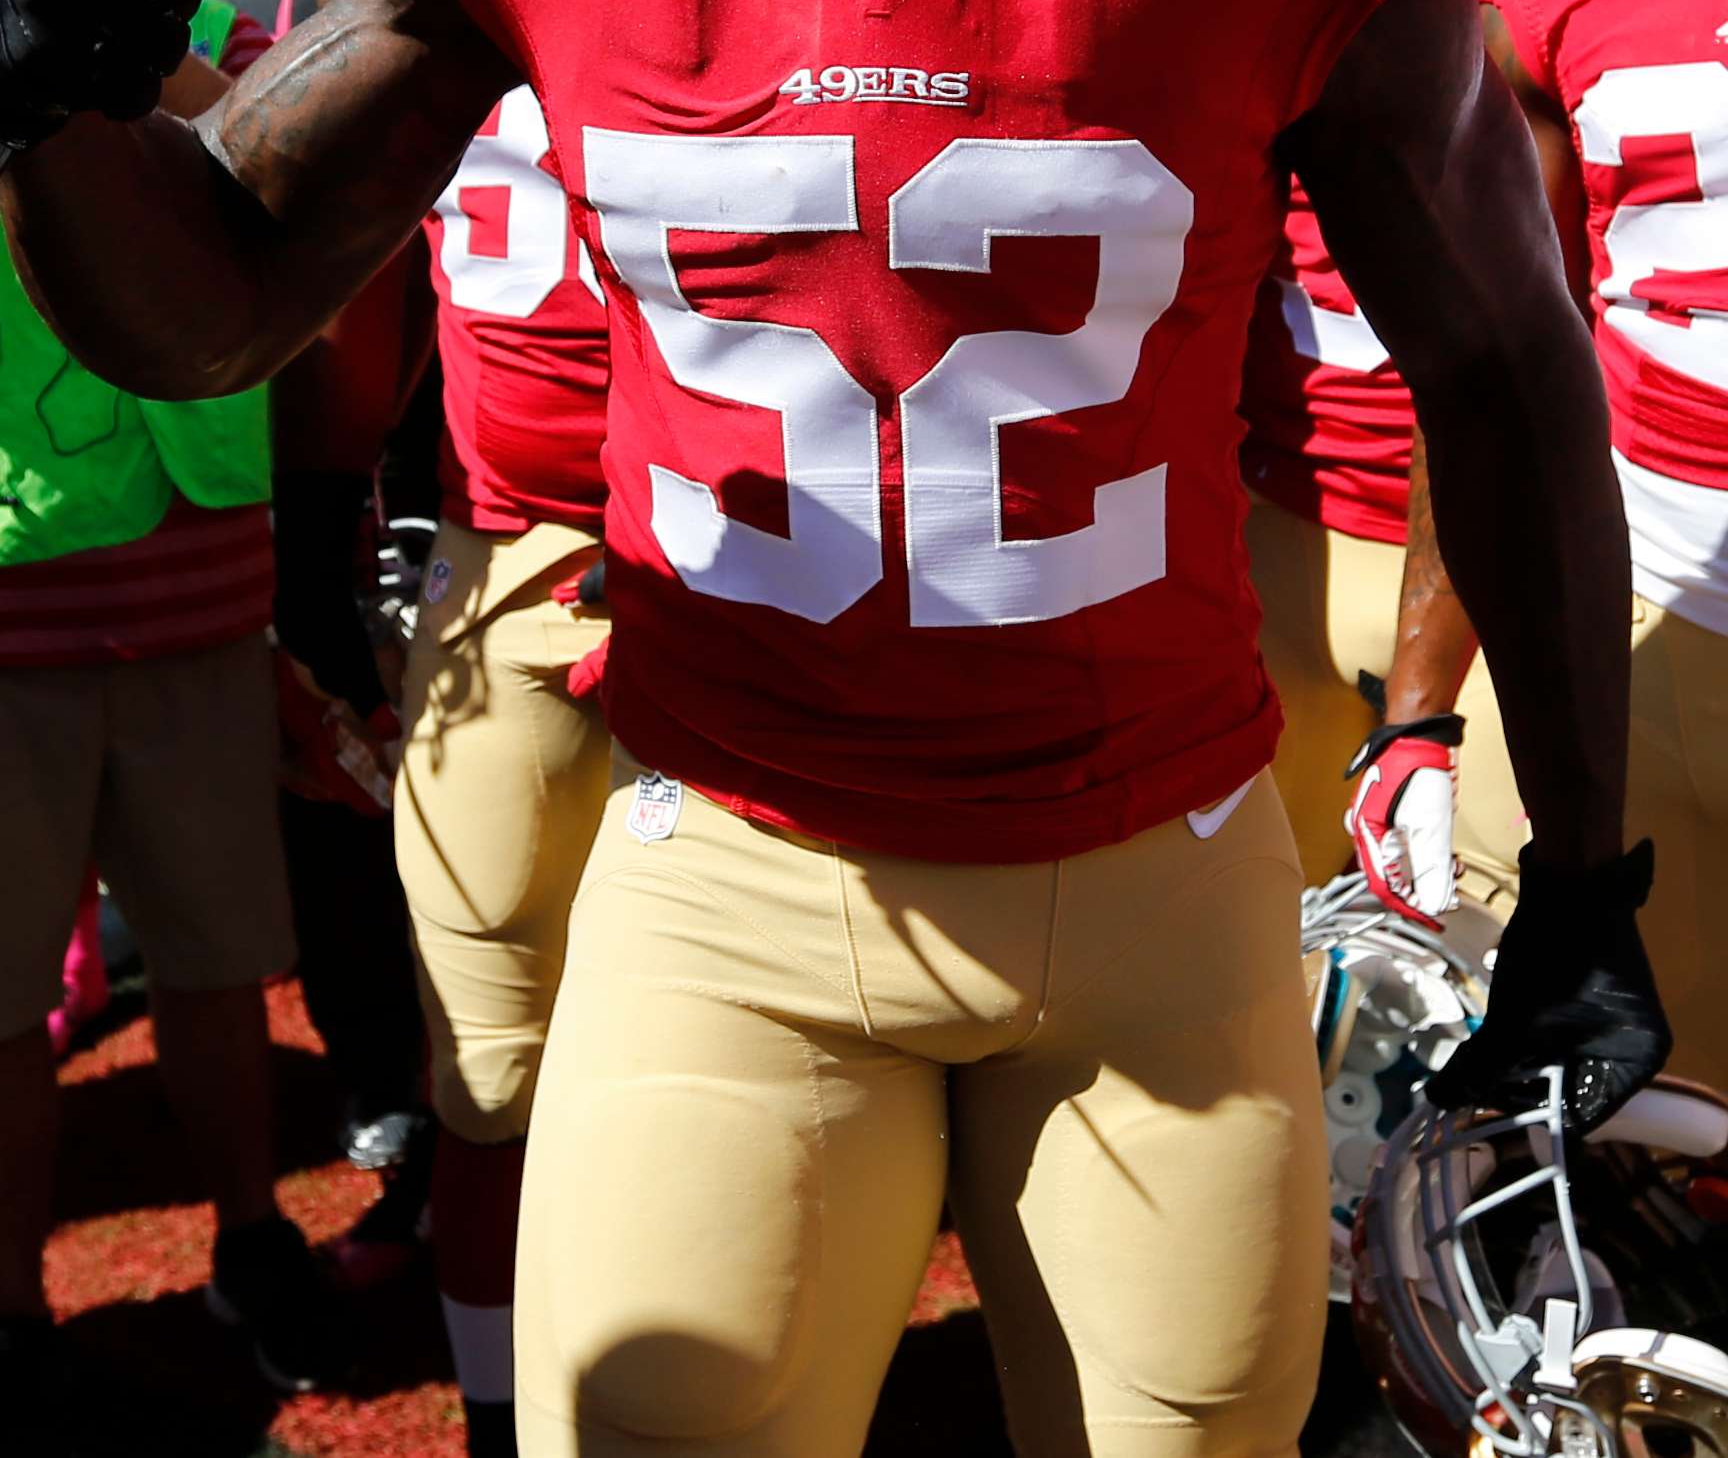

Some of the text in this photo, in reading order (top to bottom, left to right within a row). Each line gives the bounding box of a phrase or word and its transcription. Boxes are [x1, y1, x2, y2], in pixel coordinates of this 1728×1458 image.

[778, 65, 970, 106] 49ERS
[583, 125, 1195, 628] 52
[635, 801, 668, 831] NFL
